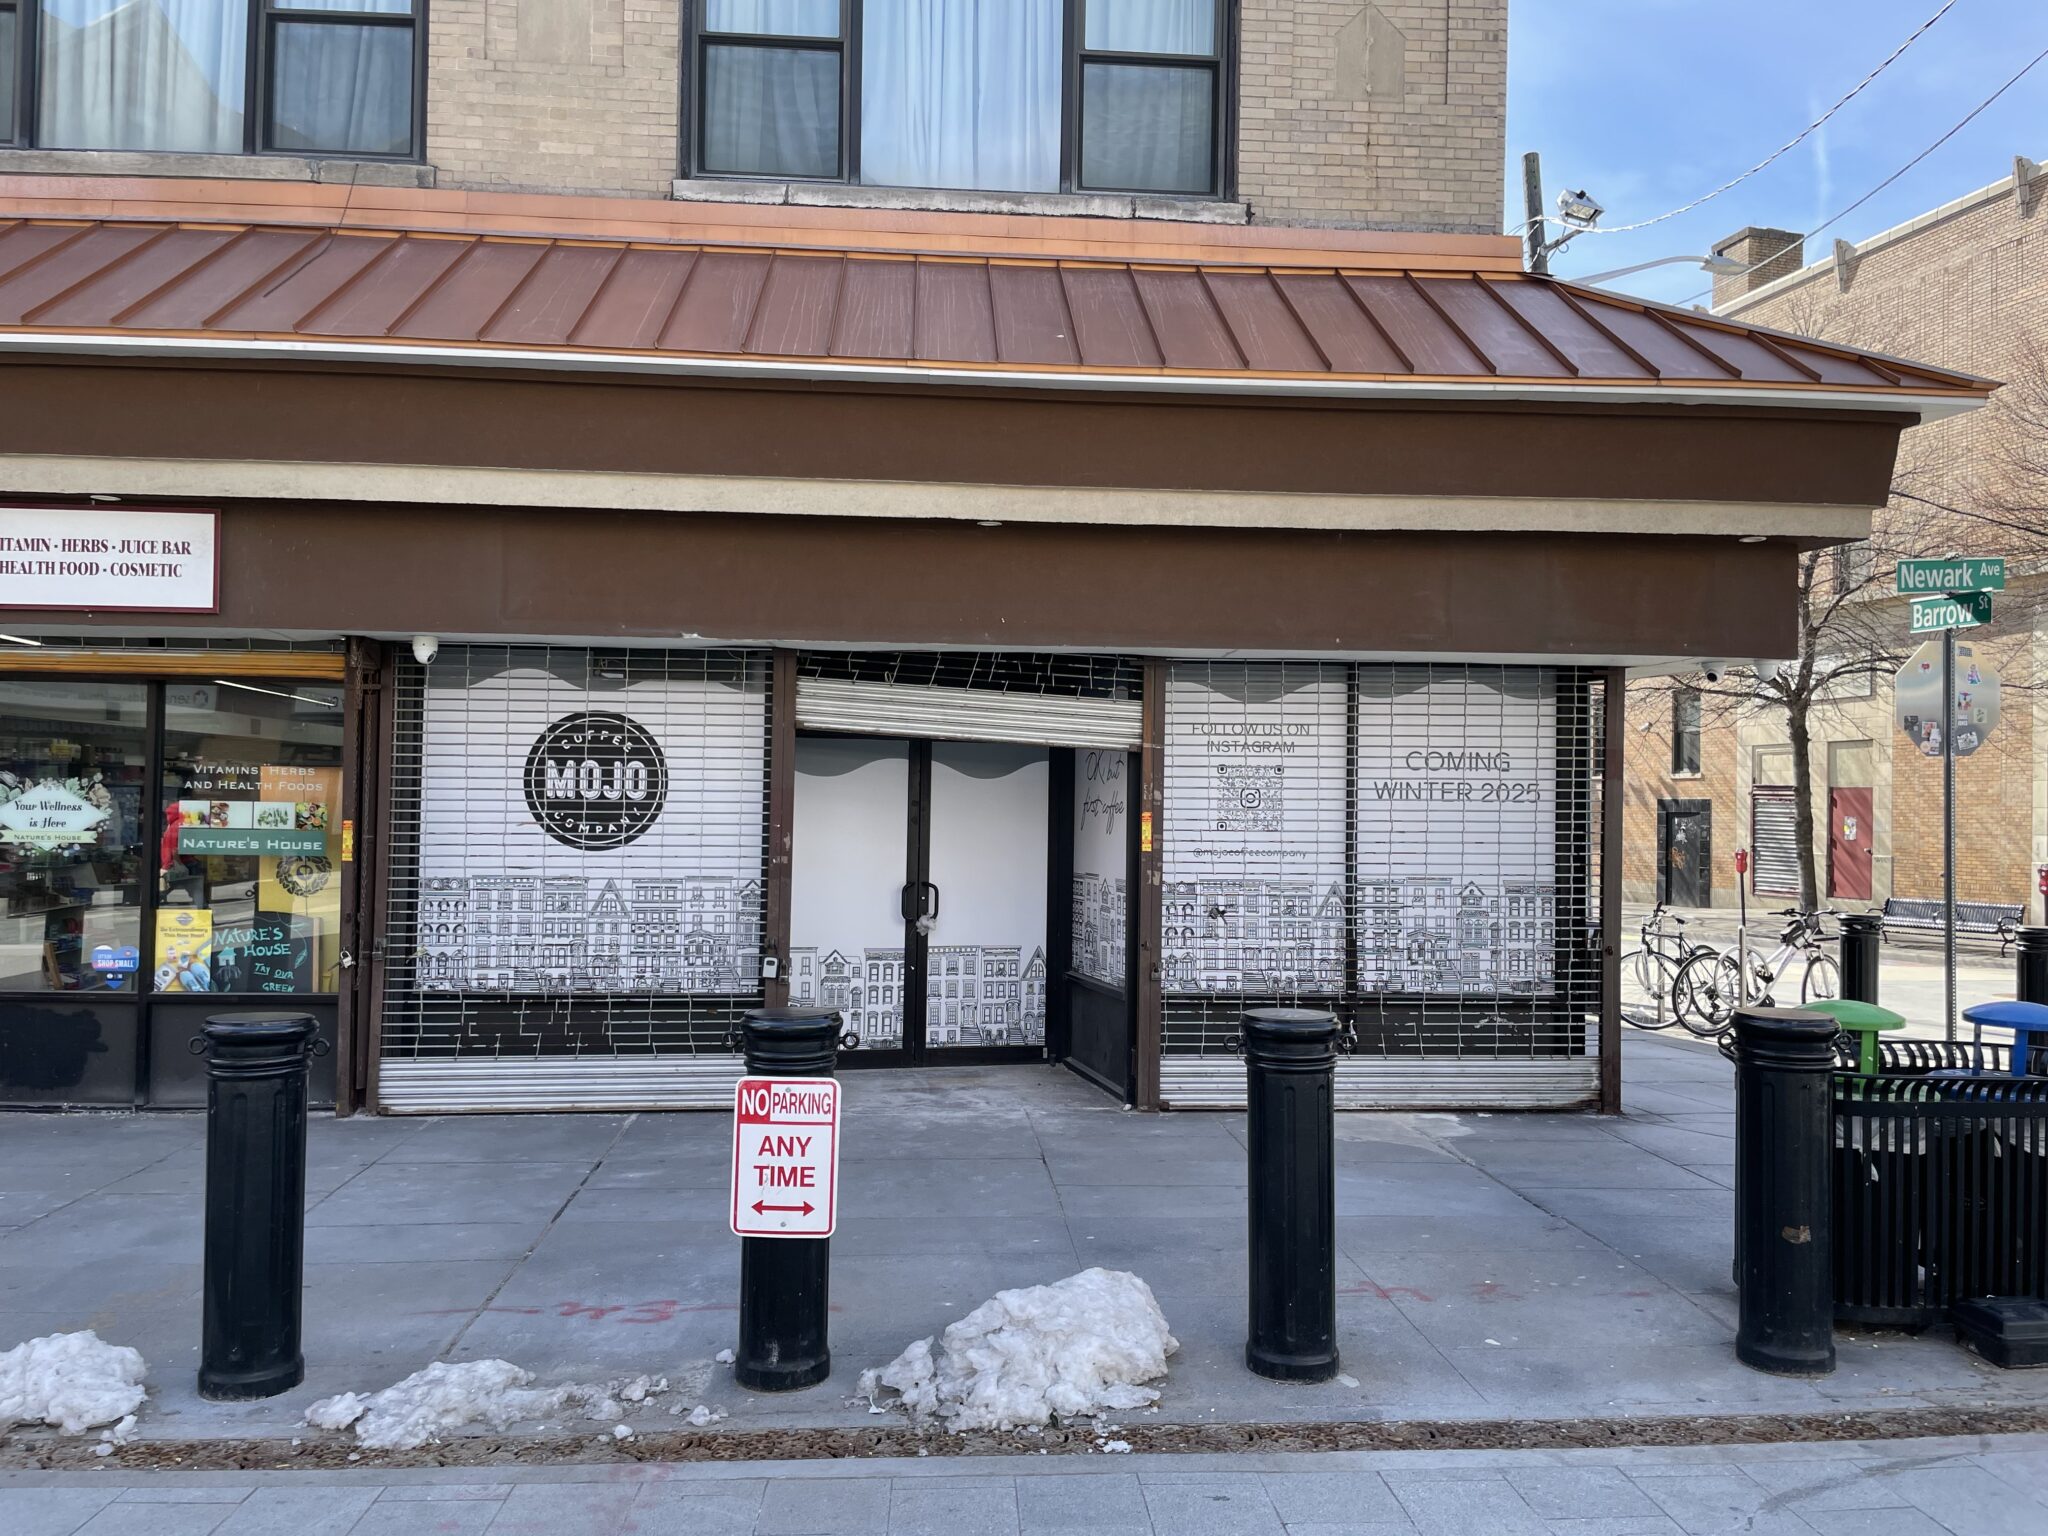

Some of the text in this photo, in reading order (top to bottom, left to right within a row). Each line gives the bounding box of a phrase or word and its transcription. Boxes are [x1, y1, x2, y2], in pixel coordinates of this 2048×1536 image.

[61, 539, 109, 553] HERBS
[118, 540, 158, 554] JUICE
[162, 541, 191, 555] BAR
[0, 560, 182, 577] HEALTH FOOD COSMETIC
[1901, 562, 2000, 588] Newark Ave
[1913, 596, 1989, 628] Barrow St
[1193, 724, 1310, 736] FOLLOW US ON
[1207, 740, 1295, 753] INSTAGRAM
[1106, 753, 1125, 781] but
[1406, 751, 1510, 772] COMING
[270, 766, 316, 776] HERBS
[184, 780, 323, 791] AND HEALTH FOODS
[546, 759, 647, 800] MOJO
[1374, 781, 1541, 803] WINTER 2025
[14, 800, 83, 811] Your Wellness
[1080, 787, 1103, 831] first
[1102, 790, 1125, 835] coffee
[29, 816, 67, 828] is Here
[183, 837, 323, 851] NATURE'S HOUSE
[243, 943, 292, 957] HOUSE
[254, 963, 294, 979] TRY OUR
[262, 982, 295, 993] GREEN
[741, 1088, 831, 1116] NO PARKING
[758, 1135, 812, 1157] ANY
[753, 1165, 816, 1188] TIME
